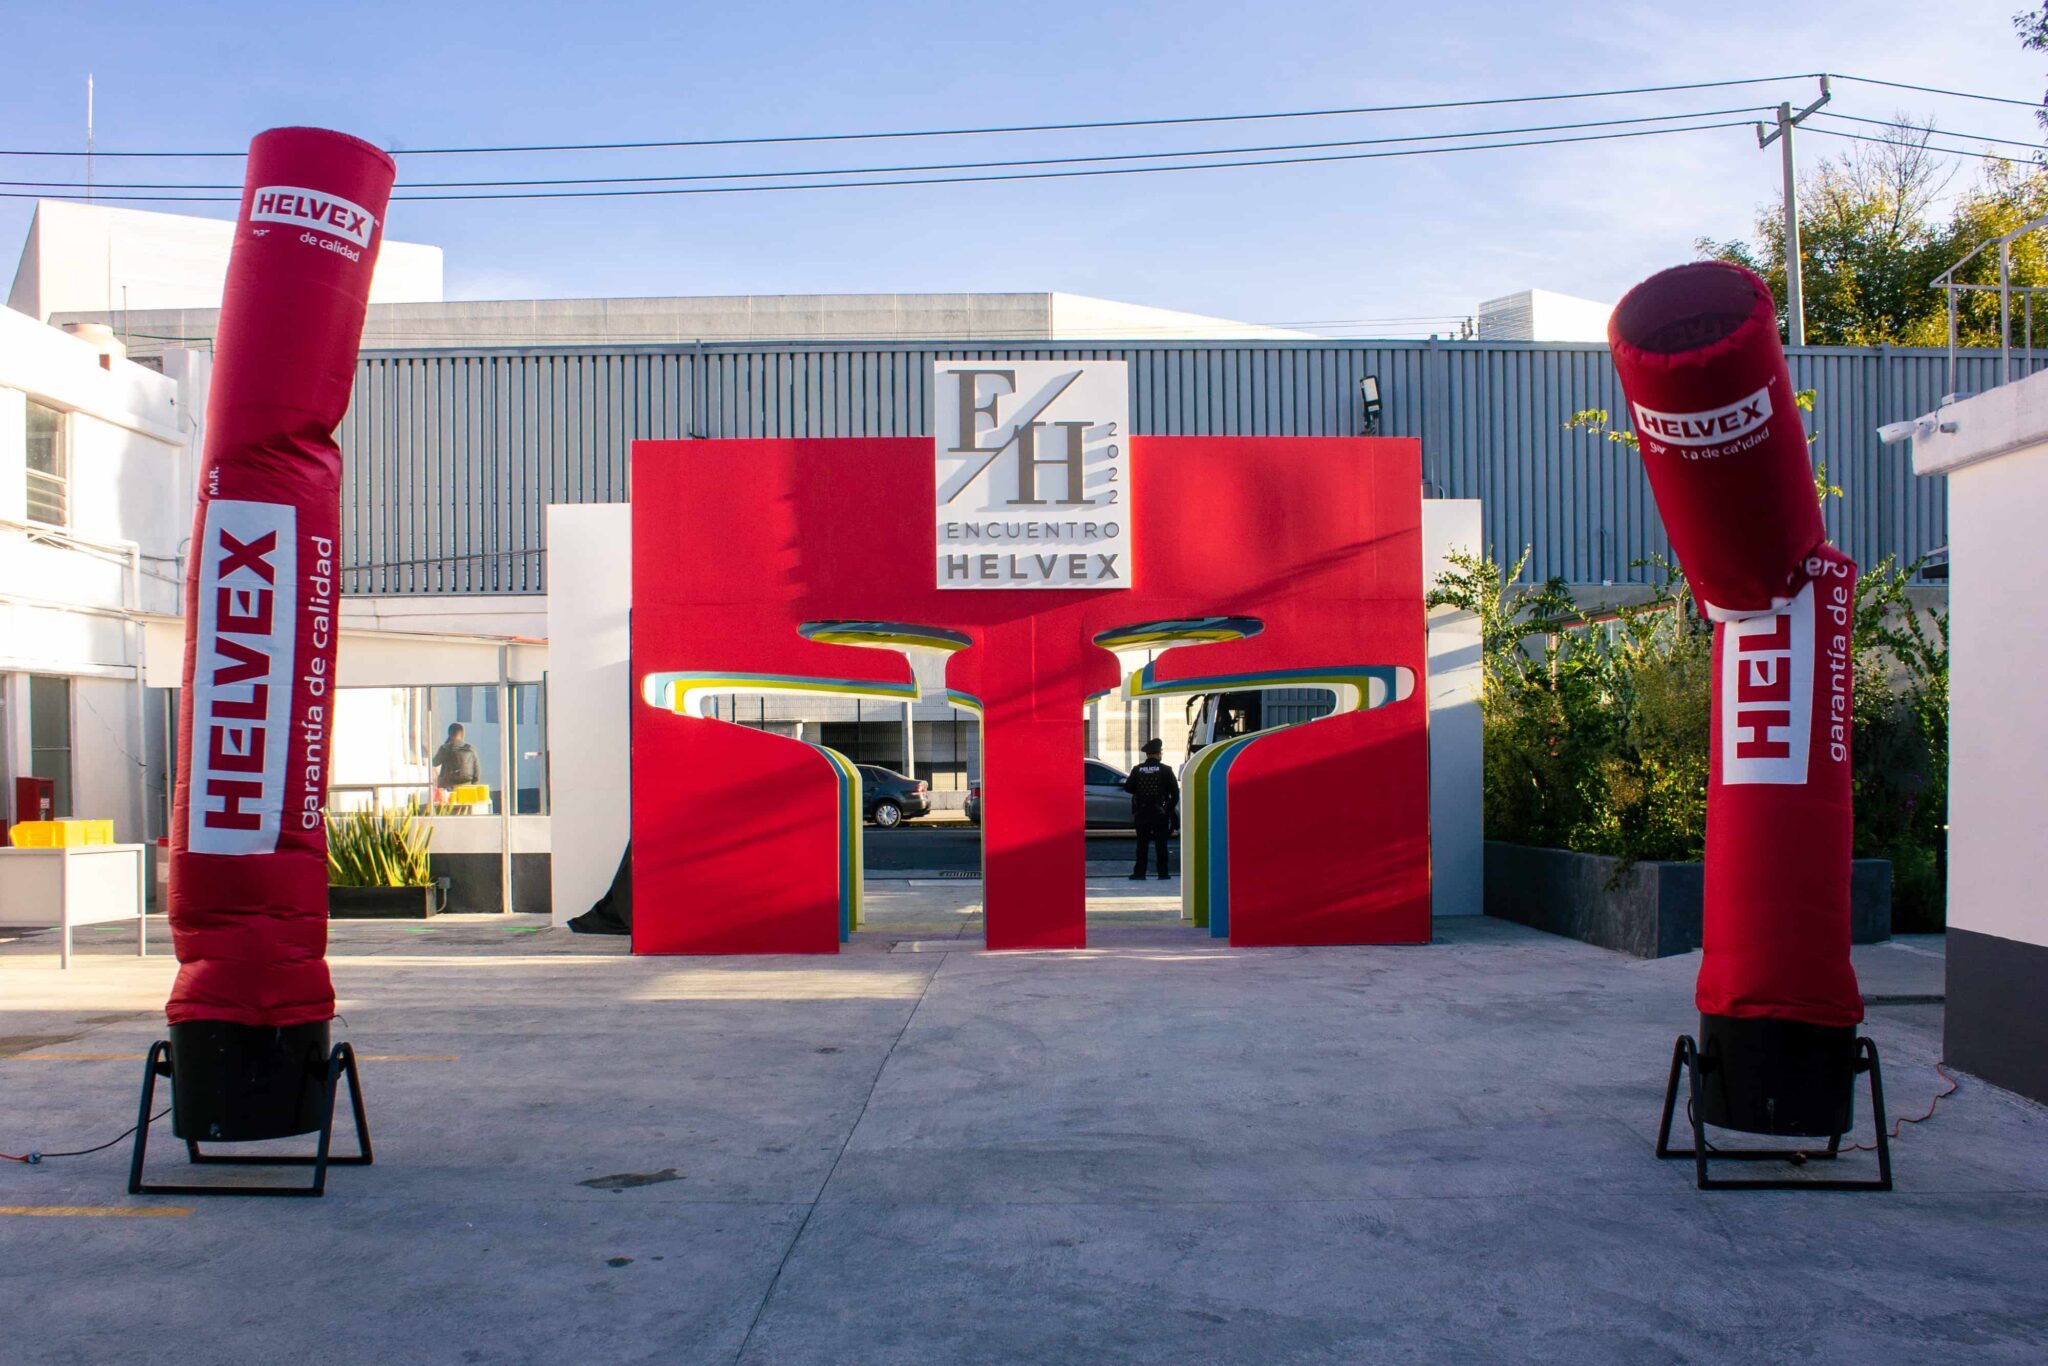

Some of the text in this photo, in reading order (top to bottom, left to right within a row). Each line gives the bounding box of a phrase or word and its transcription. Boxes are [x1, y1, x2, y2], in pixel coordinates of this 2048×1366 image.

[257, 193, 367, 238] HELVEX
[299, 231, 360, 263] de calidad
[1640, 398, 1764, 438] HELVEX
[1701, 447, 1720, 459] de
[209, 466, 219, 495] M.R.
[947, 521, 1120, 539] ENCUENTRO
[947, 553, 1120, 579] HELVEX
[204, 527, 278, 832] HELVEX
[301, 535, 333, 830] garantía de calidad
[1736, 613, 1791, 759] HEL
[1826, 586, 1848, 763] garantía de
